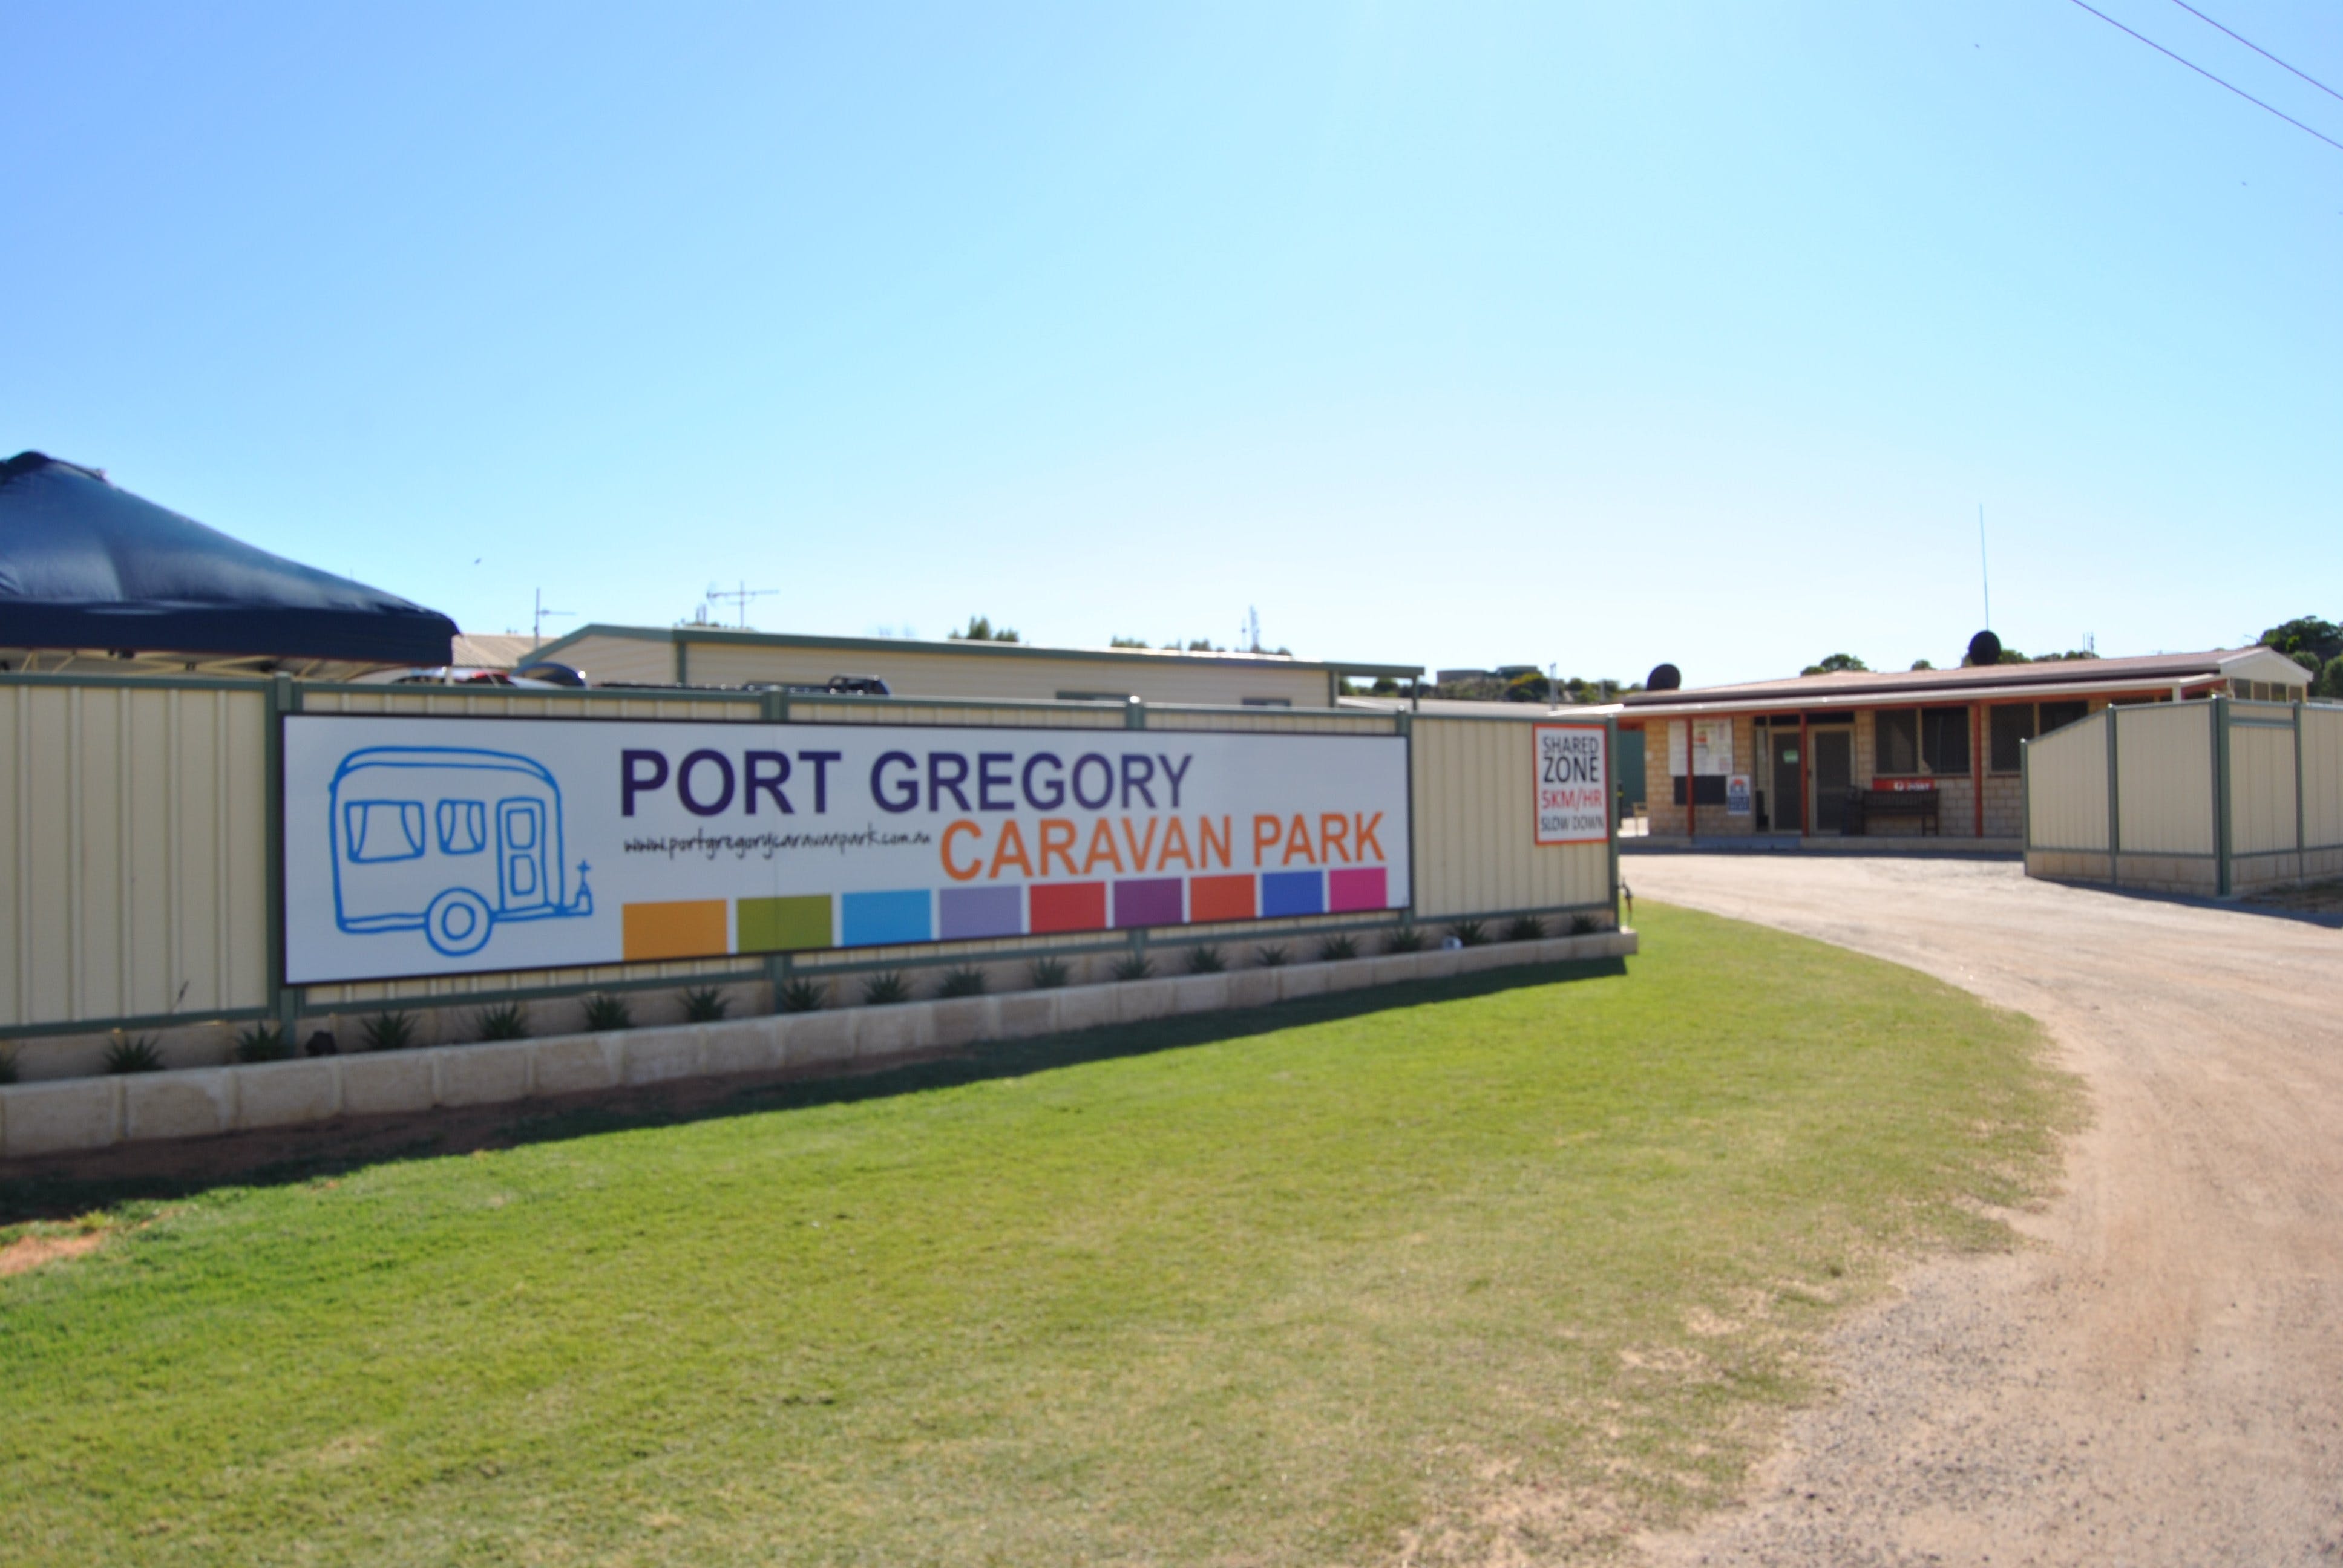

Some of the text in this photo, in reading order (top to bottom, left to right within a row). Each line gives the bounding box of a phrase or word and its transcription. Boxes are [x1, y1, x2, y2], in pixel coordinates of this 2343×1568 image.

[1543, 736, 1599, 754] SHARED
[621, 749, 1193, 817] PORT GREGORY
[1544, 756, 1599, 783] ZONE
[1542, 788, 1602, 811] 5KM/HR
[1541, 815, 1604, 832] SLOW DOWN
[623, 824, 931, 859] www.portgregorycaravanpark.com.au
[940, 811, 1385, 881] CARAVAN PARK
